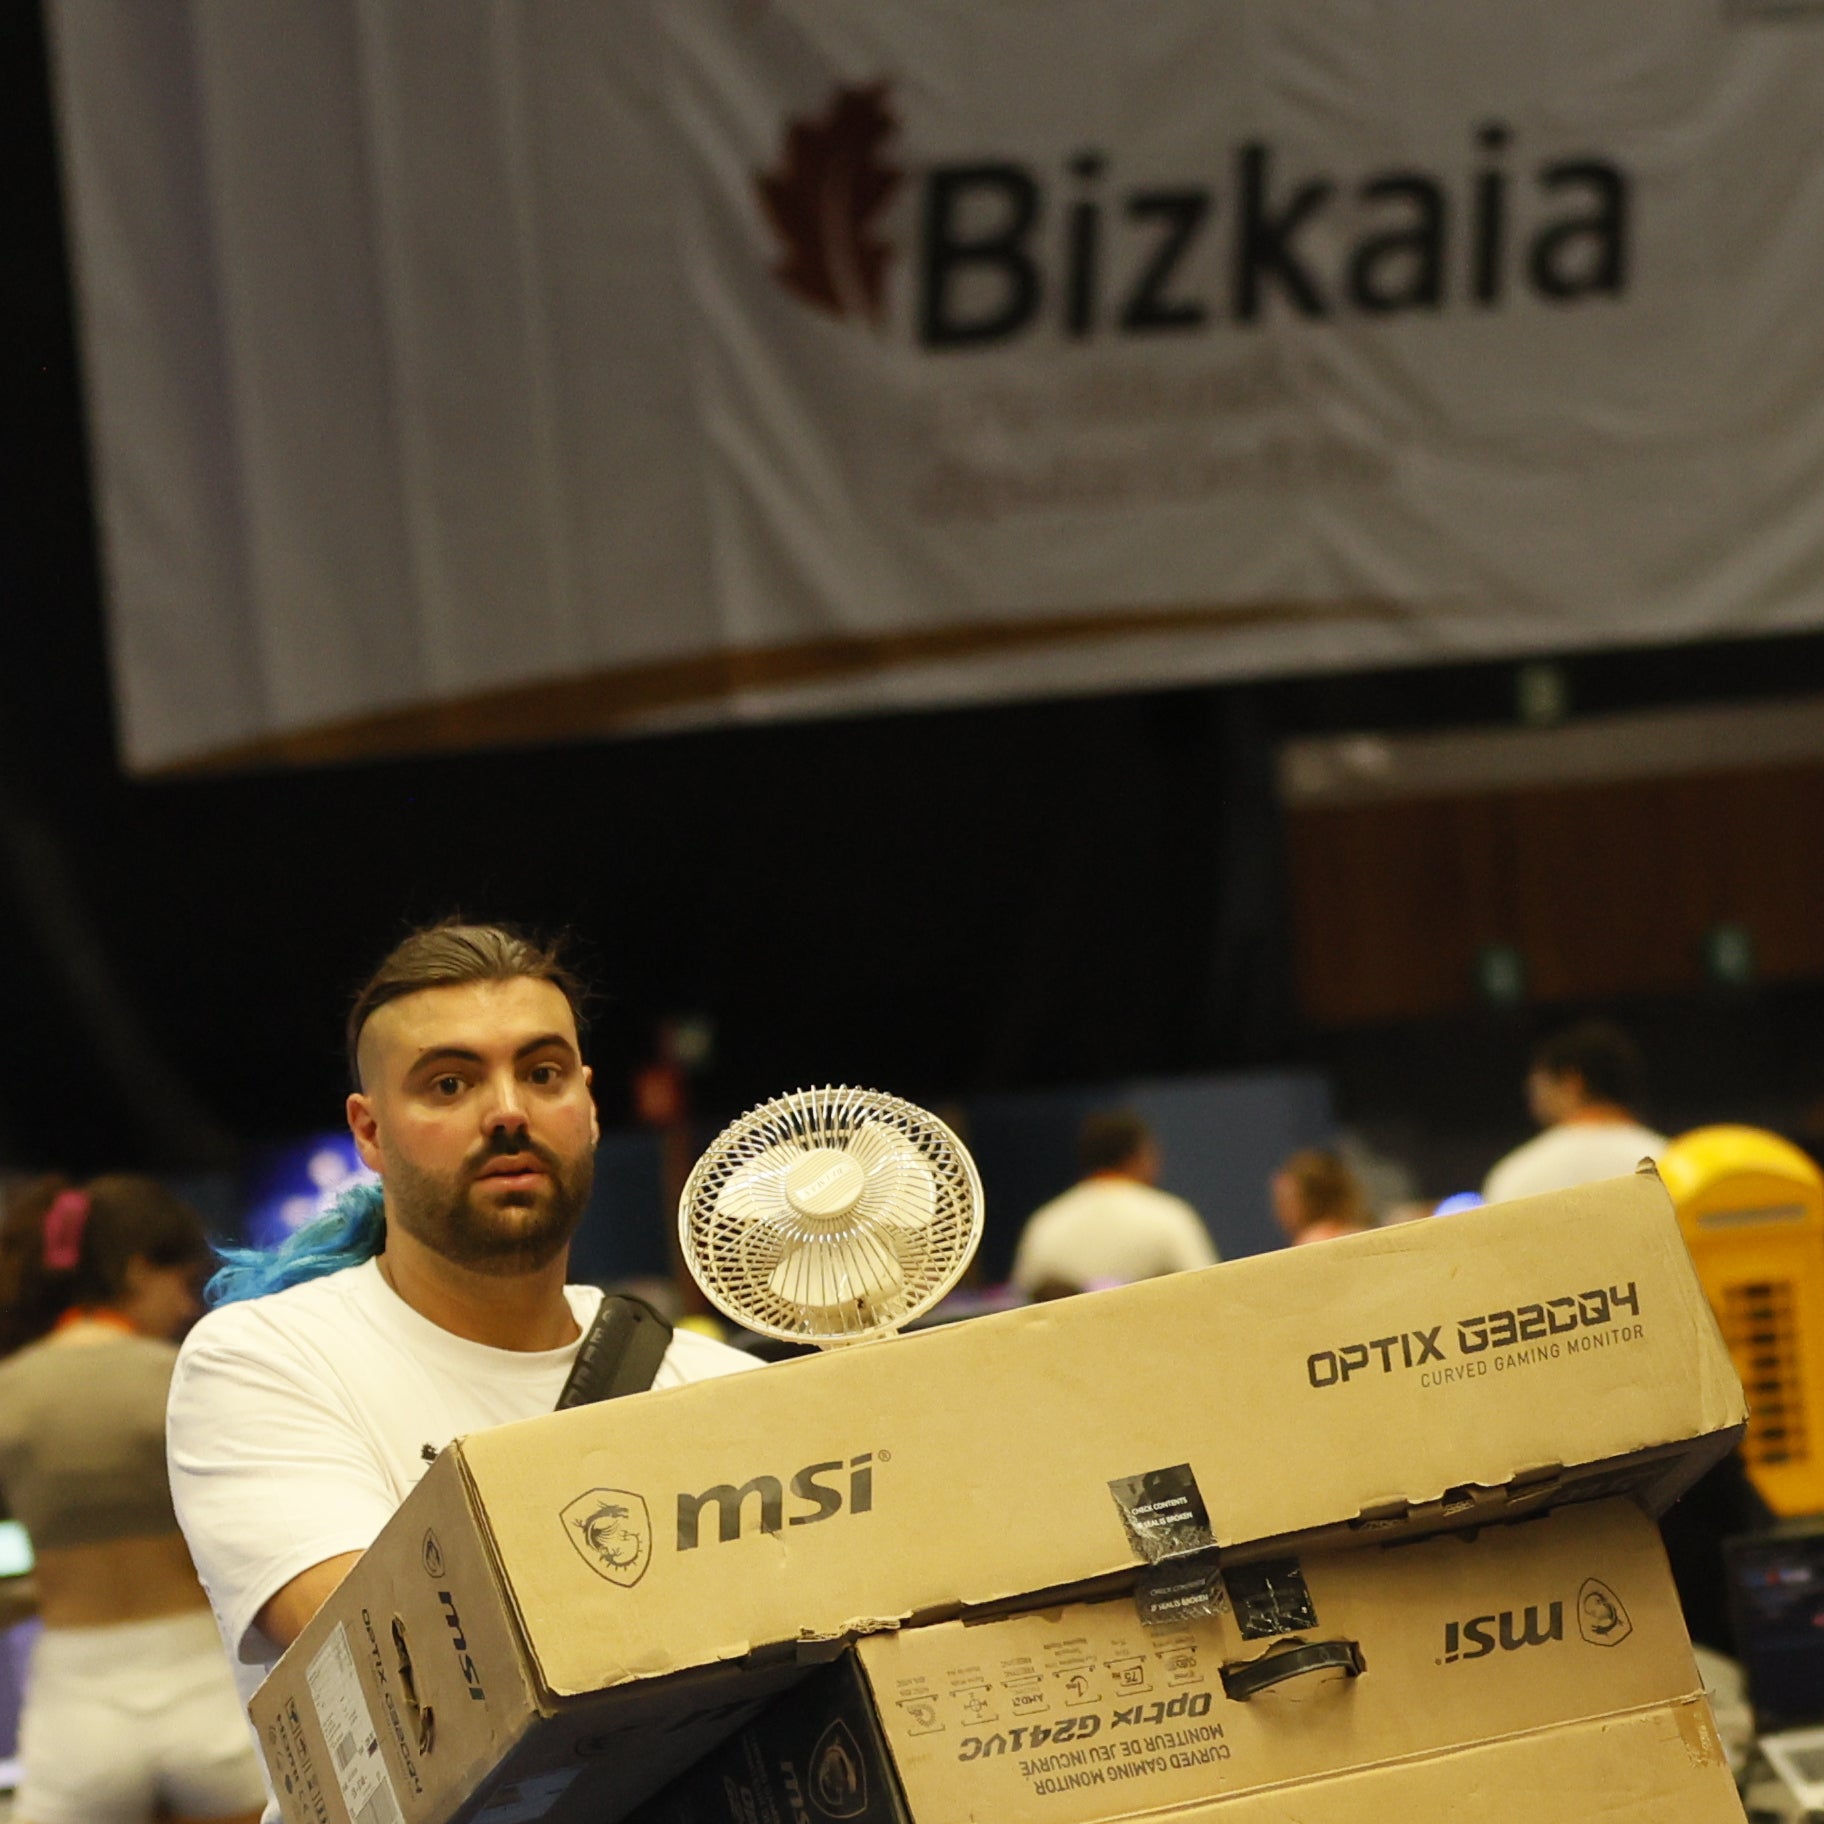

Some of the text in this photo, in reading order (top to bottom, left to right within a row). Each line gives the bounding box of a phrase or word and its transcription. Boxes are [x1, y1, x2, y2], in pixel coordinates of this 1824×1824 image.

[917, 123, 1632, 353] Bizkaia
[1307, 1326, 1446, 1388] OPTIX
[1421, 1323, 1644, 1388] CURVED GAMING MONITOR
[676, 1452, 873, 1552] msi
[362, 1608, 387, 1685] OPTIX
[437, 1591, 486, 1701] msi
[1445, 1601, 1563, 1664] msi
[959, 1714, 1101, 1761] G241VC
[1091, 1744, 1119, 1765] JEU
[1122, 1739, 1143, 1757] DE
[1145, 1723, 1224, 1751] MONITEUR
[1035, 1744, 1231, 1795] CURVED GAMING MONITOR
